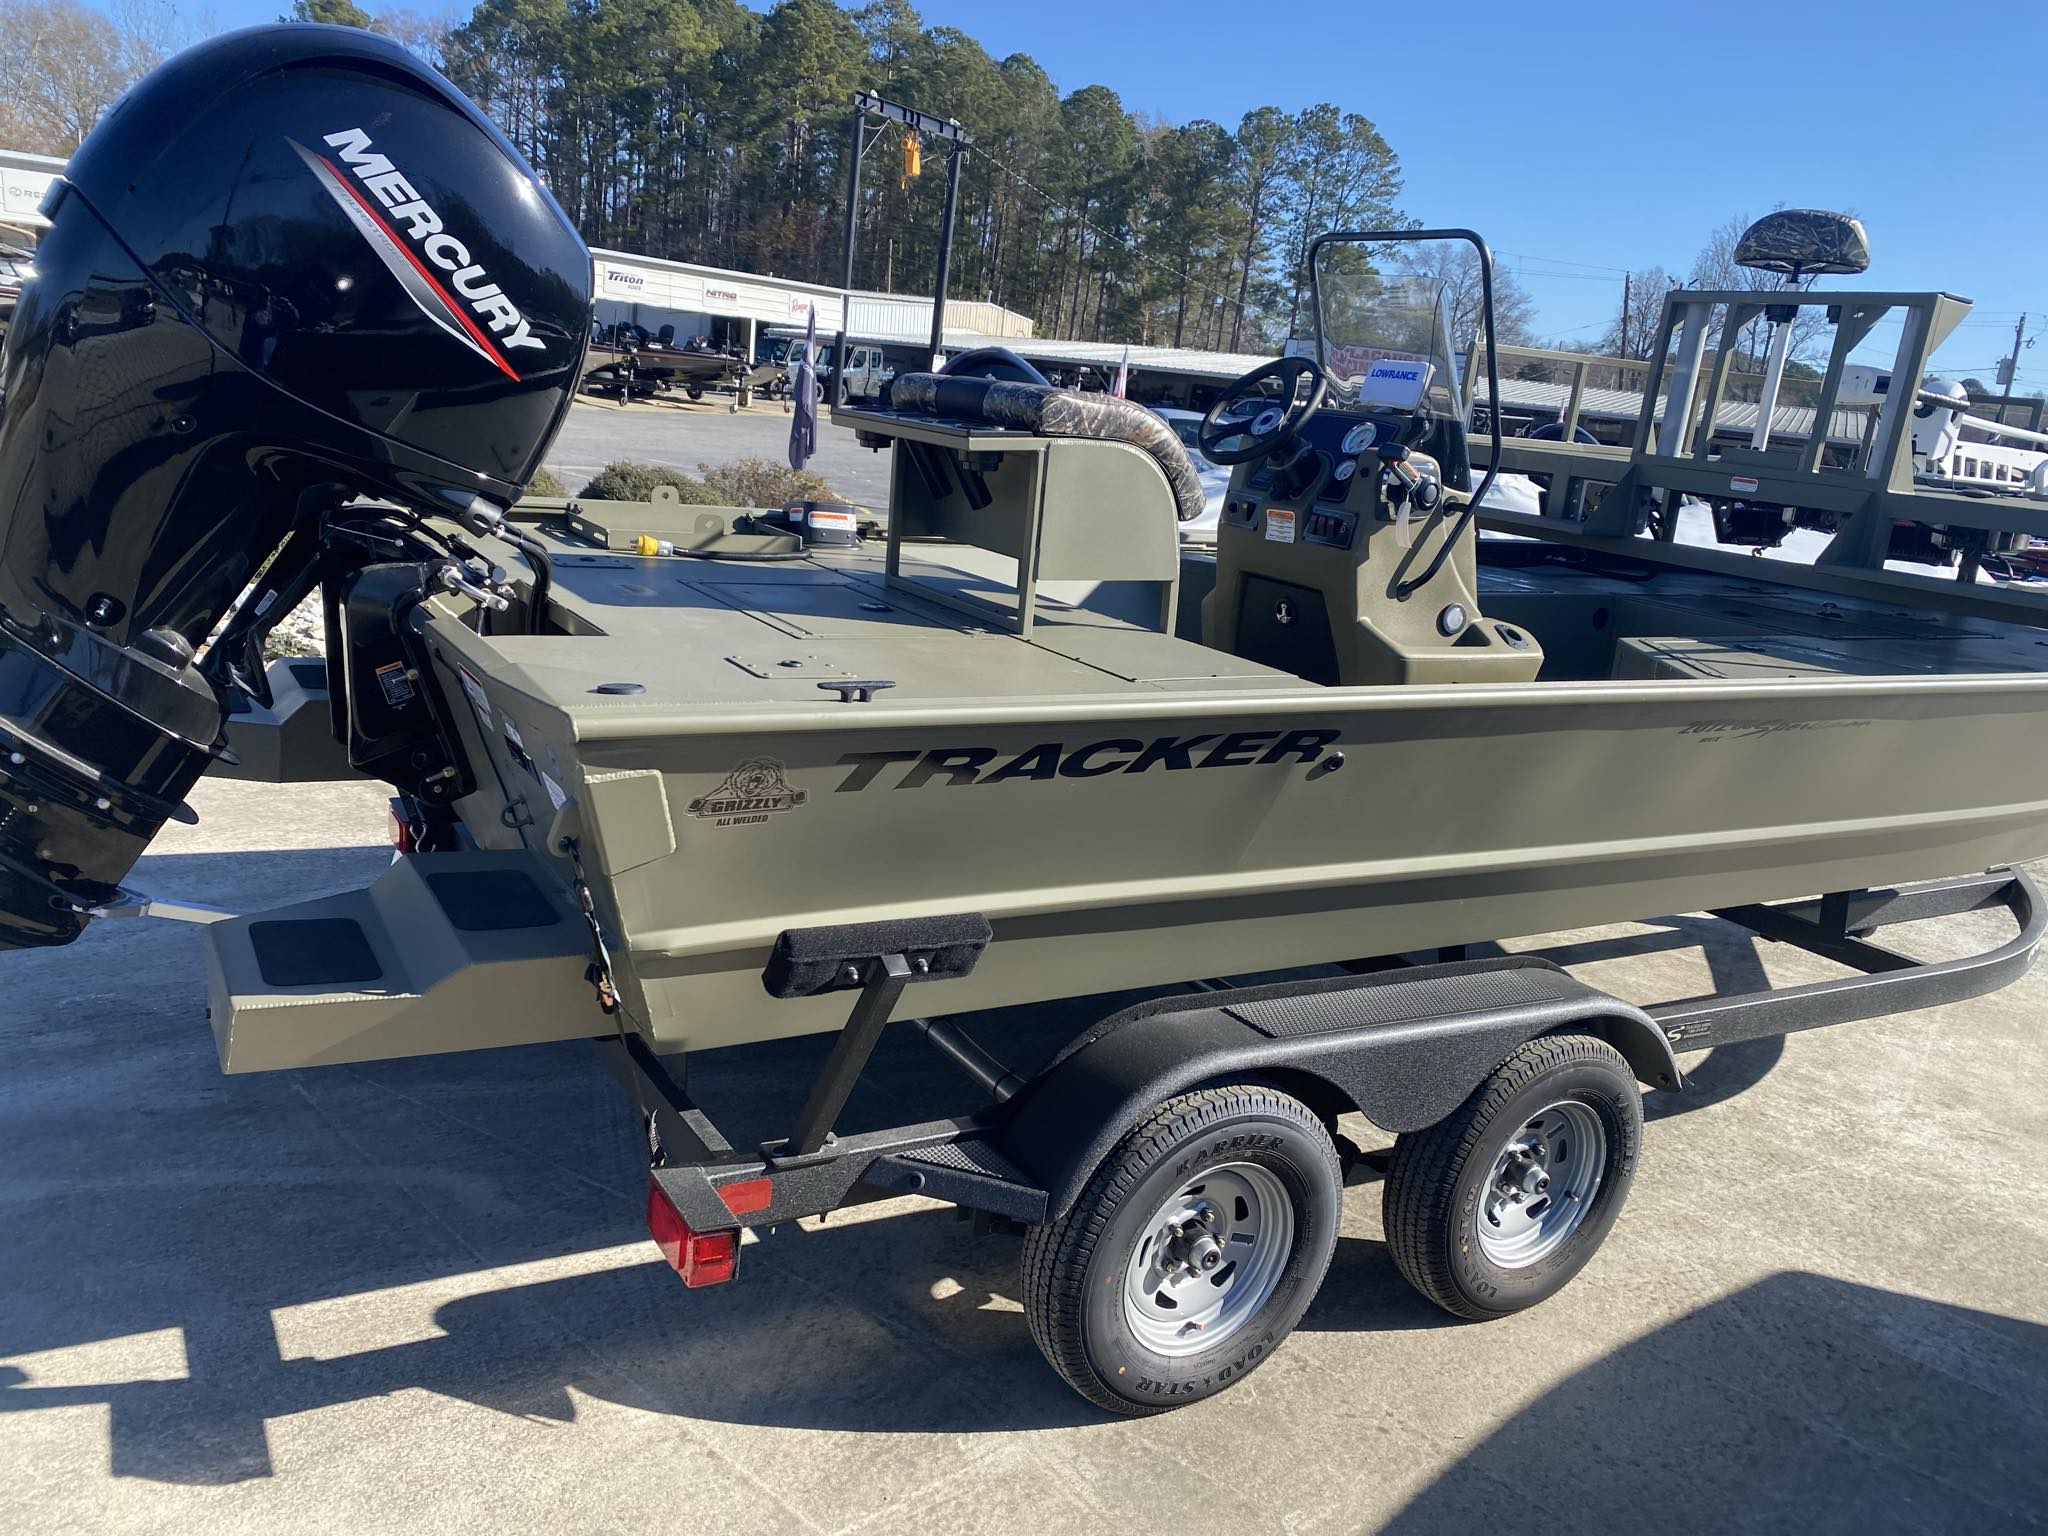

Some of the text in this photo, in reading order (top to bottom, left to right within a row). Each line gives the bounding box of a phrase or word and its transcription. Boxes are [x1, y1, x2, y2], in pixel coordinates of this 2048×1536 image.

[323, 127, 546, 349] MERCURY
[607, 270, 644, 285] Triton
[705, 289, 737, 300] NITRO
[790, 298, 809, 315] Range
[1371, 368, 1419, 382] LOWRANCE
[834, 728, 1342, 793] TRACKER
[711, 797, 783, 813] GRIZZLY
[716, 814, 769, 827] ALL WELDED
[1135, 1330, 1275, 1396] LOAD STAR
